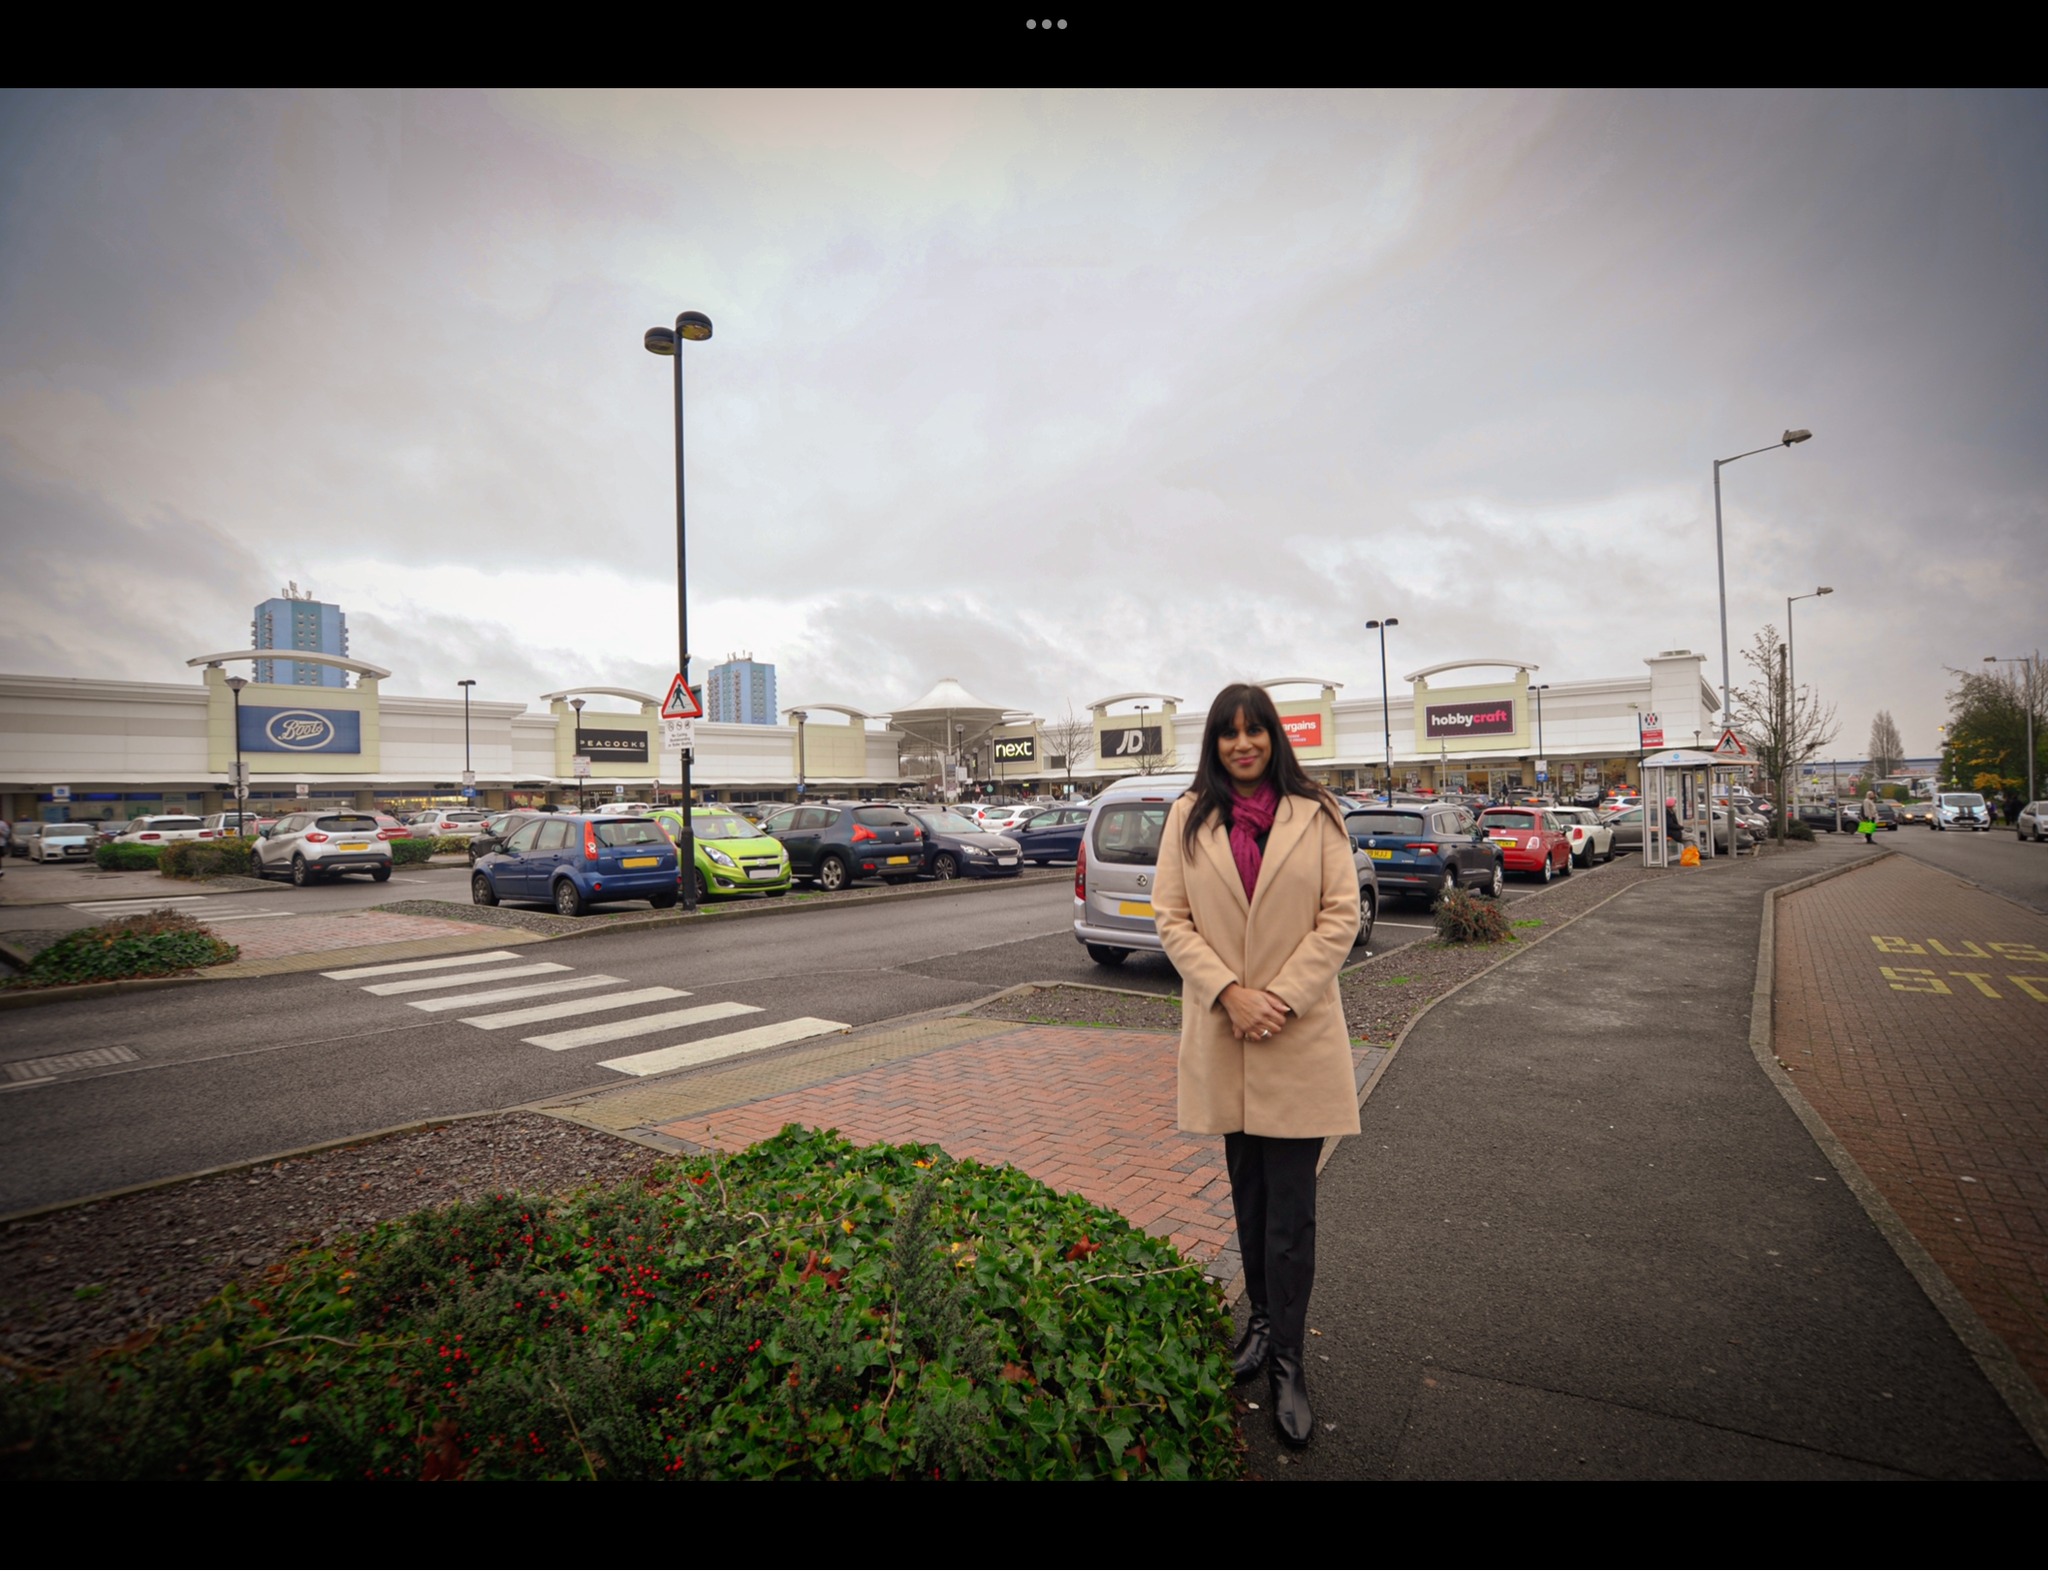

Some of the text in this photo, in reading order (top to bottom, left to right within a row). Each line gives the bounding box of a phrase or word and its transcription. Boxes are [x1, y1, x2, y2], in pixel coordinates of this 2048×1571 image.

[1281, 720, 1317, 733] argains
[1431, 709, 1507, 727] hobbycraft
[277, 719, 324, 740] Boots
[580, 740, 646, 748] PEACOCKS
[995, 741, 1033, 758] next
[1116, 729, 1145, 755] JD
[1870, 935, 2048, 963] BUS
